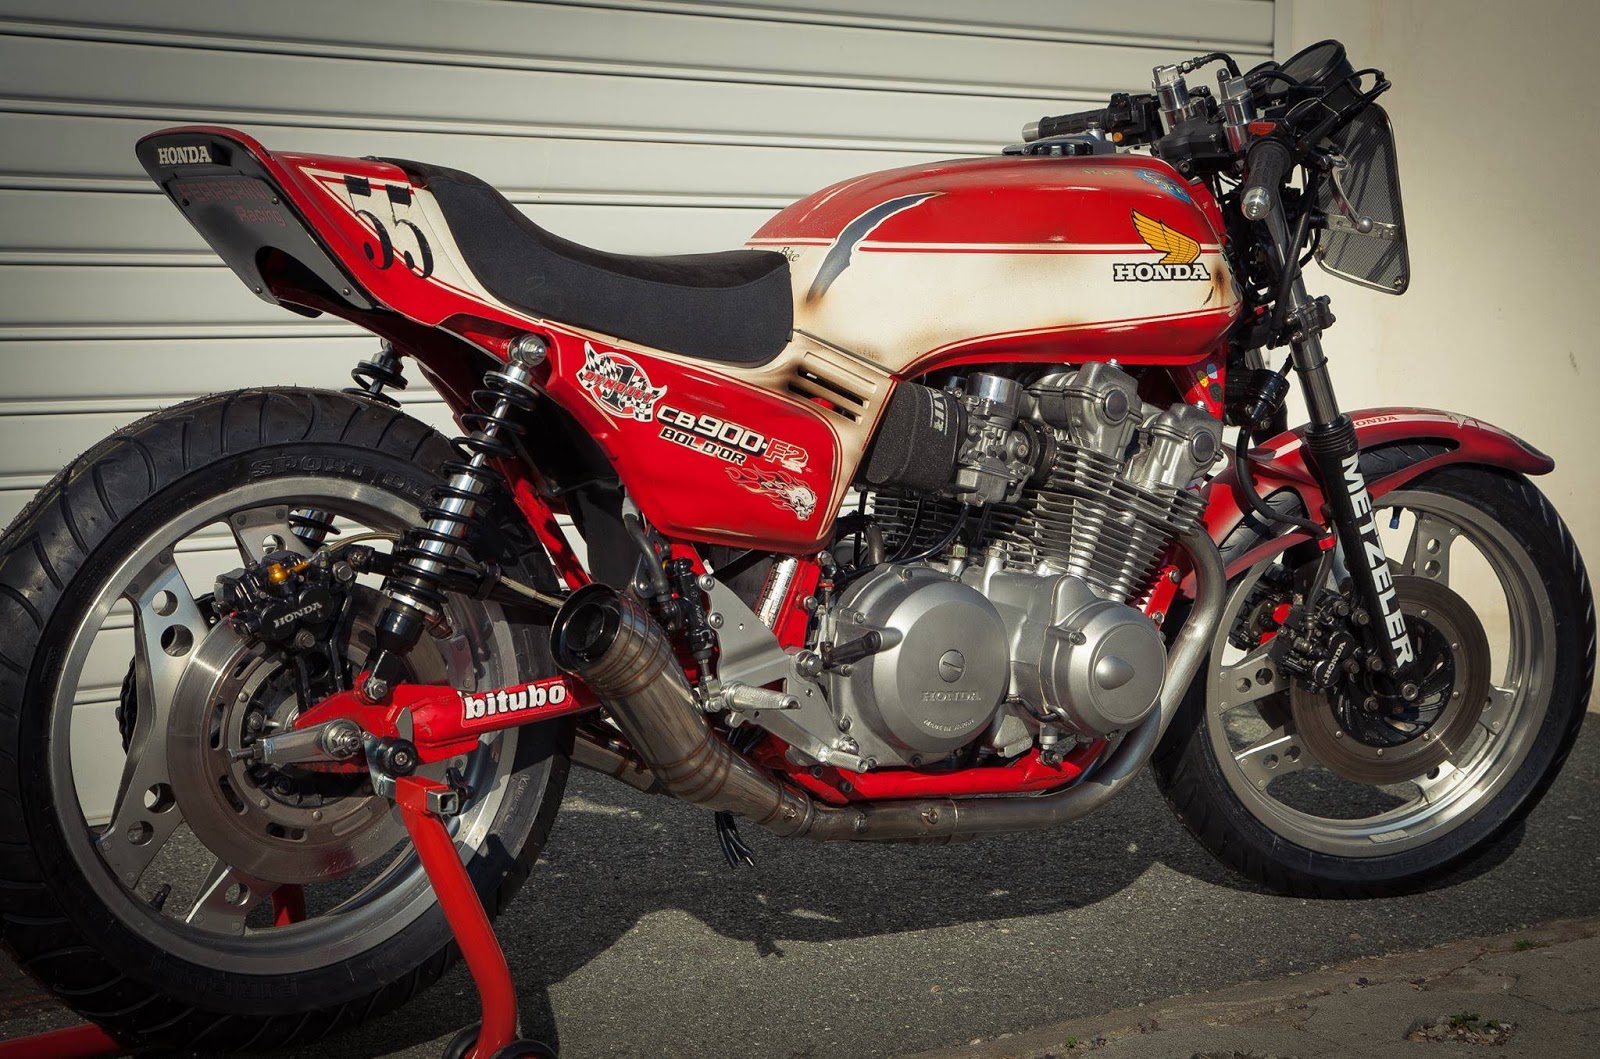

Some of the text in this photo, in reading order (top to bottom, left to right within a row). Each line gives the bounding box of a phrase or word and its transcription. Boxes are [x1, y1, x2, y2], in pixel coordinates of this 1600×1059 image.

[157, 145, 212, 165] HONDA
[344, 175, 434, 279] 55
[1113, 263, 1211, 282] HONDA
[1354, 415, 1399, 427] ONDA
[659, 426, 747, 466] BOL D'OR
[1341, 452, 1414, 668] METZELER
[273, 601, 323, 629] HONDA
[1322, 641, 1347, 685] HONDA
[464, 684, 566, 720] bitubo
[921, 690, 982, 702] HONDA
